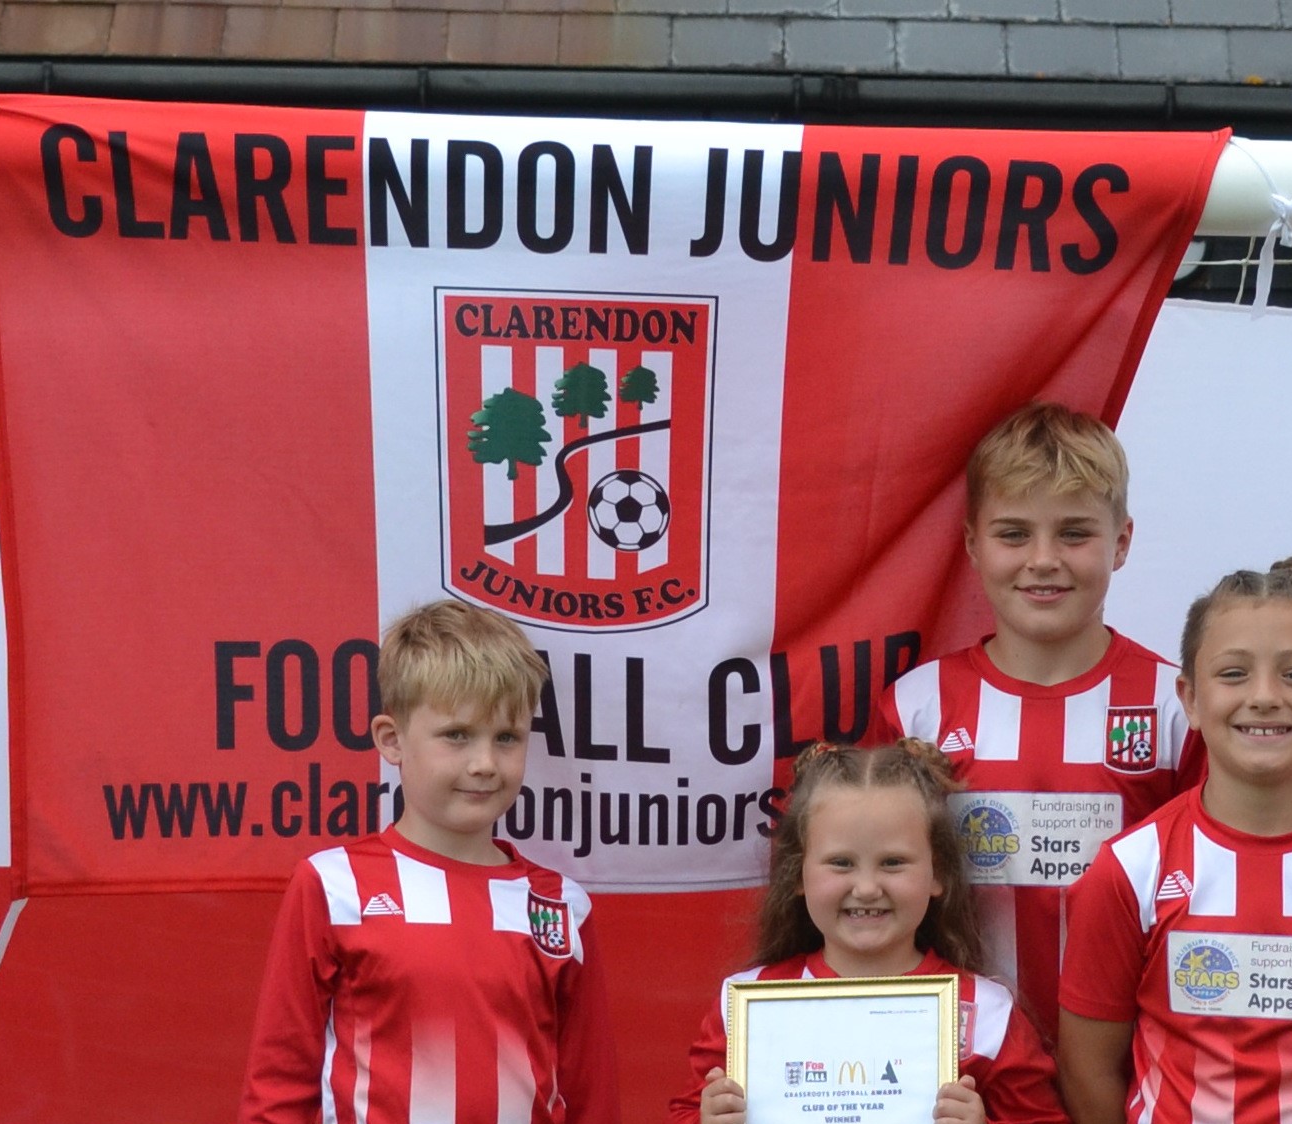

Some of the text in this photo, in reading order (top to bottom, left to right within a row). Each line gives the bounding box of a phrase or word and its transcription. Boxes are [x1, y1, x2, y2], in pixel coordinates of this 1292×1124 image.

[40, 123, 1130, 275] CLARENDON JUNIORS
[455, 303, 697, 344] CLARENDON
[460, 560, 695, 619] JUNIORS F.C.
[216, 638, 671, 764] FOOALL
[1032, 800, 1115, 814] Fundraising in
[1031, 817, 1114, 831] support of the
[1030, 835, 1081, 853] Stars
[1250, 958, 1292, 970] support
[1174, 968, 1240, 990] STARS
[784, 1088, 903, 1098] GRASSROOTS FOOTBALL AWARDS
[802, 1102, 885, 1112] CLUB OF THE YEAR
[824, 1115, 861, 1123] WINNER
